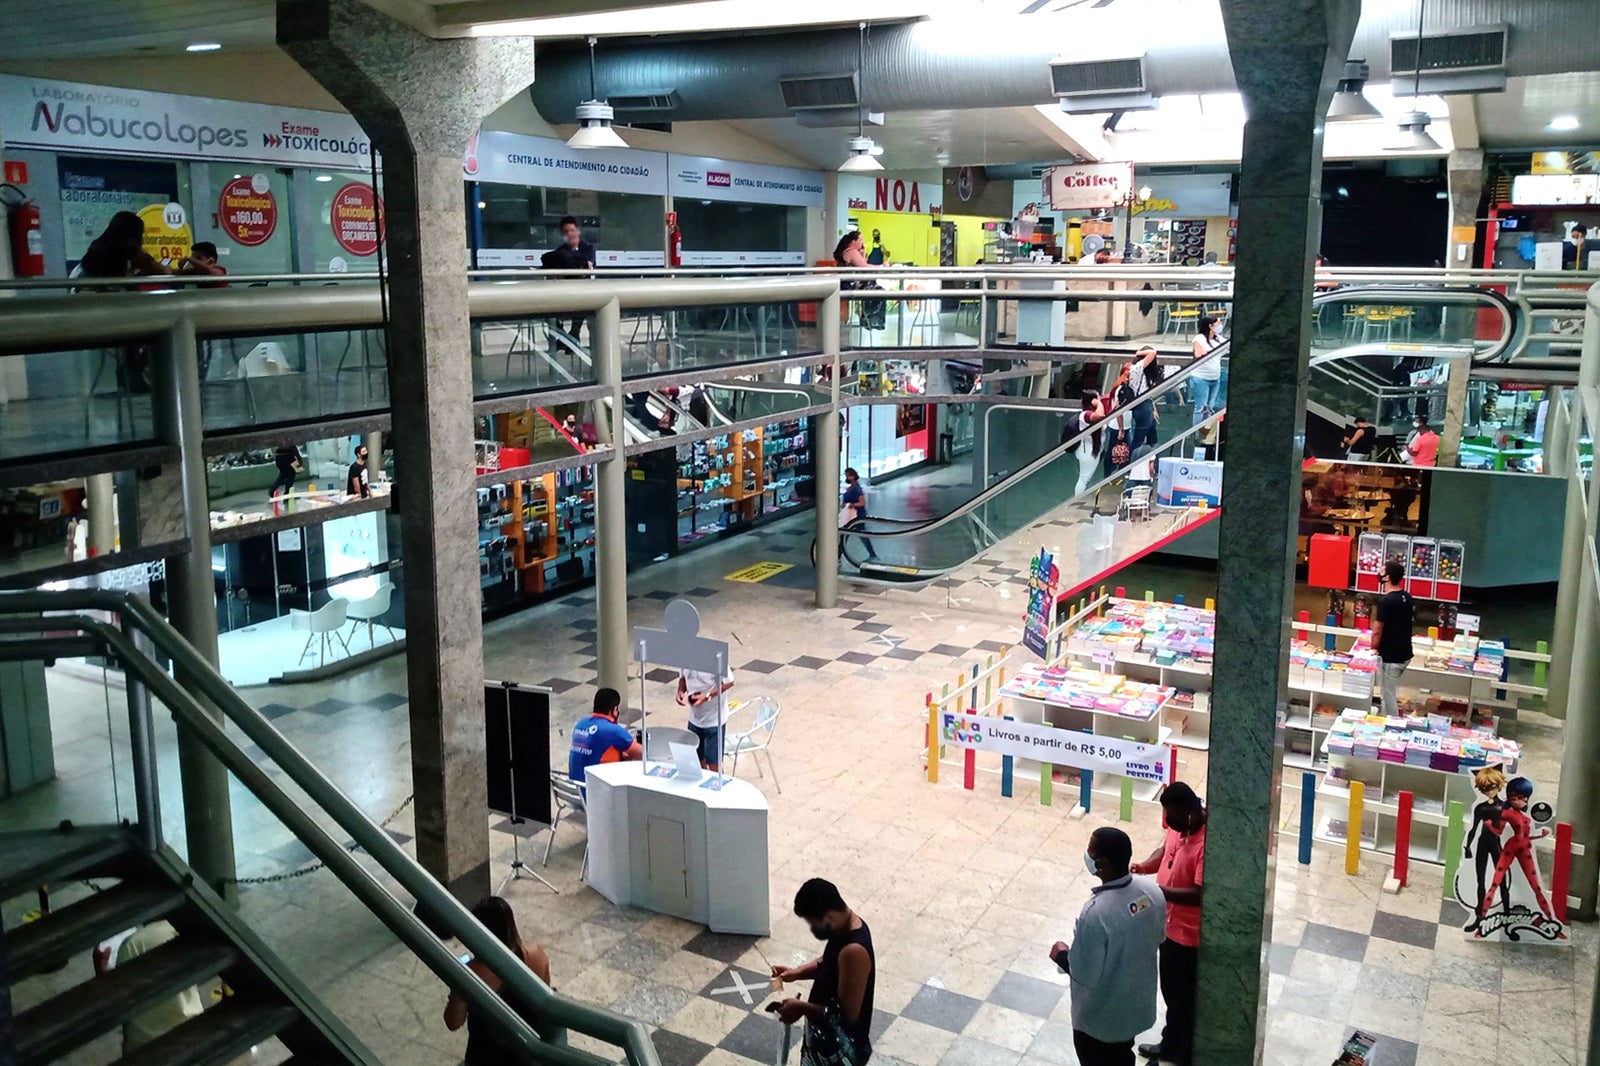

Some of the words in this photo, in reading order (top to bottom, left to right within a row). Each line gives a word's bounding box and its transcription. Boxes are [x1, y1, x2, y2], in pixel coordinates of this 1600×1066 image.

[282, 122, 319, 136] Exame
[282, 136, 369, 155] TOXICOLÓG
[508, 154, 541, 166] CENTRAL
[544, 158, 553, 167] DE
[556, 160, 606, 172] ATENDIMENTO
[608, 165, 618, 174] AO
[620, 166, 650, 177] CIDADÃO
[735, 178, 755, 187] CENTRAL
[764, 182, 795, 191] ATENDIMENTO
[1064, 175, 1118, 188] Coffee
[875, 178, 920, 213] NOA
[989, 728, 1021, 741] Livros
[1033, 736, 1062, 748] partir
[1065, 741, 1077, 752] de
[1081, 744, 1095, 755] R$
[1099, 747, 1122, 759] 5,00
[1126, 762, 1150, 771] LIVRO
